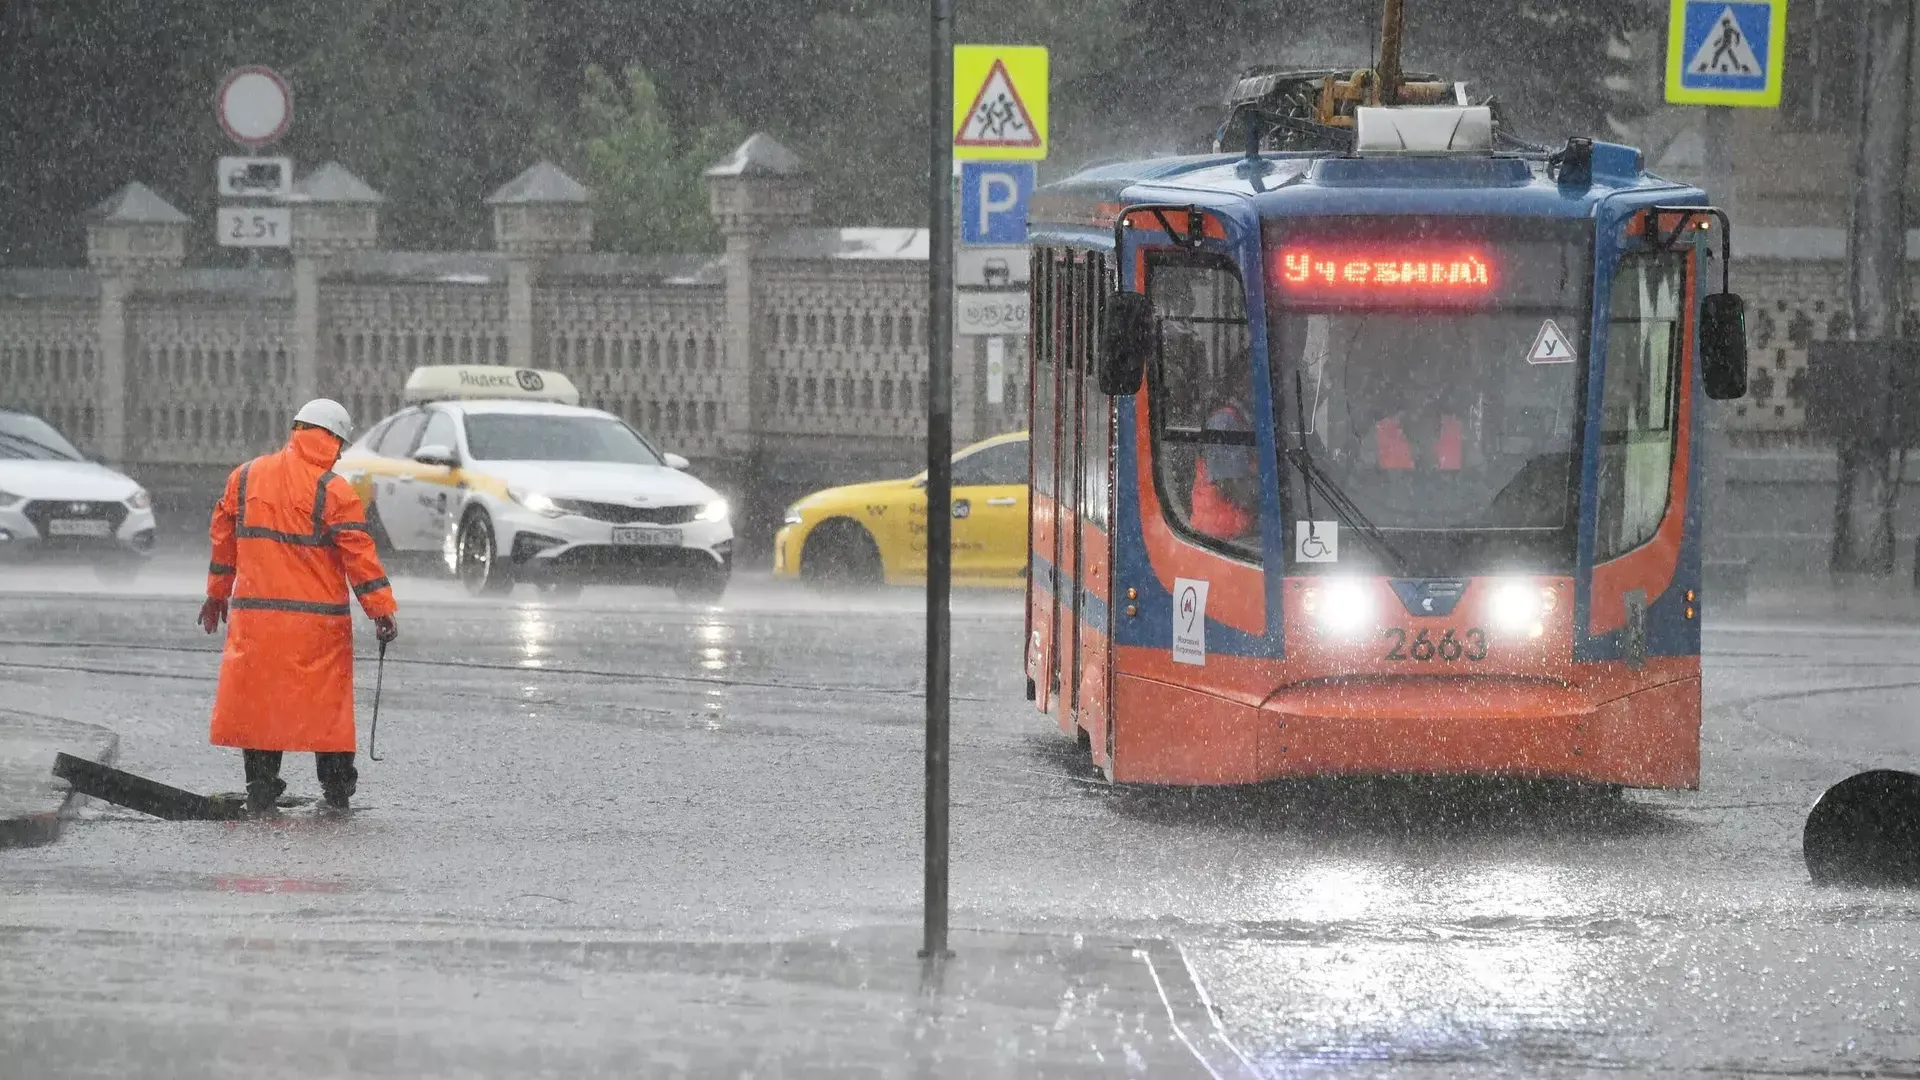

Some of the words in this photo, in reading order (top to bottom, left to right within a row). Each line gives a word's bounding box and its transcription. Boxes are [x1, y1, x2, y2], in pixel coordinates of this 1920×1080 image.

[980, 172, 1018, 235] P
[1285, 254, 1488, 284] Учебный
[983, 304, 998, 319] 15
[1004, 303, 1025, 322] 20
[458, 370, 515, 388] Яндекс
[518, 371, 542, 390] Go
[1384, 627, 1488, 662] 2663
